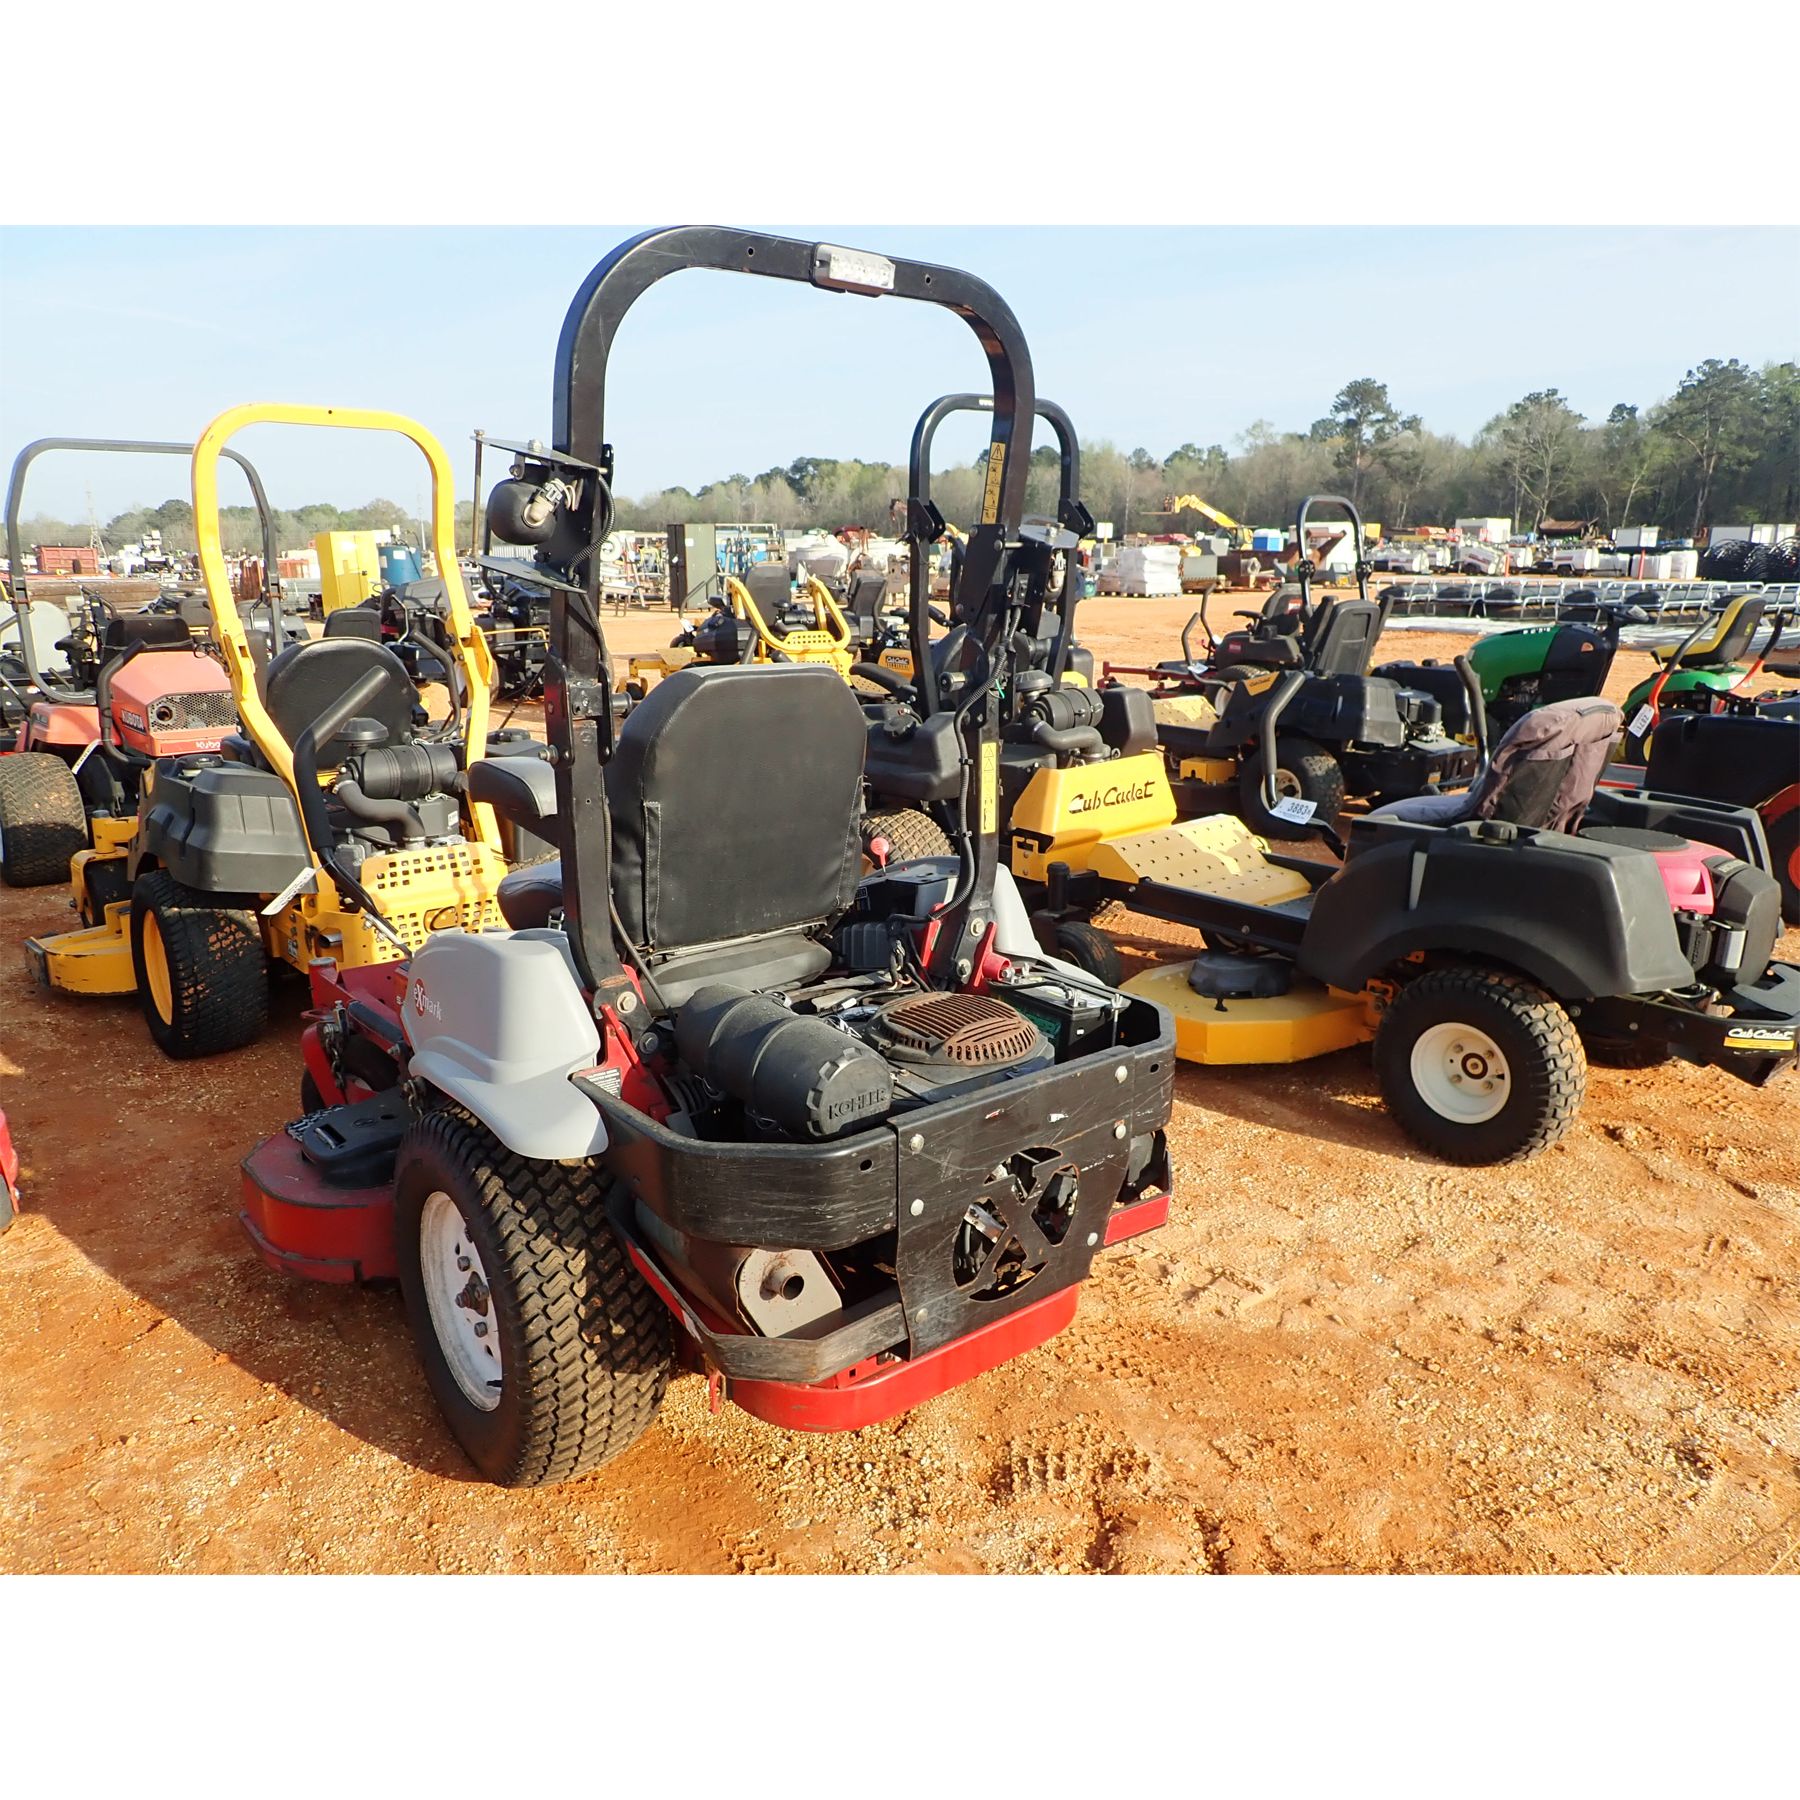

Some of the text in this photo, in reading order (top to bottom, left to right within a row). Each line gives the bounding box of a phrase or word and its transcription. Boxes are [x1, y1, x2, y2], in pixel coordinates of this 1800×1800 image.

[1069, 780, 1156, 814] Cub Cadet
[1728, 1027, 1795, 1041] Cub Cadet
[828, 1088, 886, 1119] KOHLER
